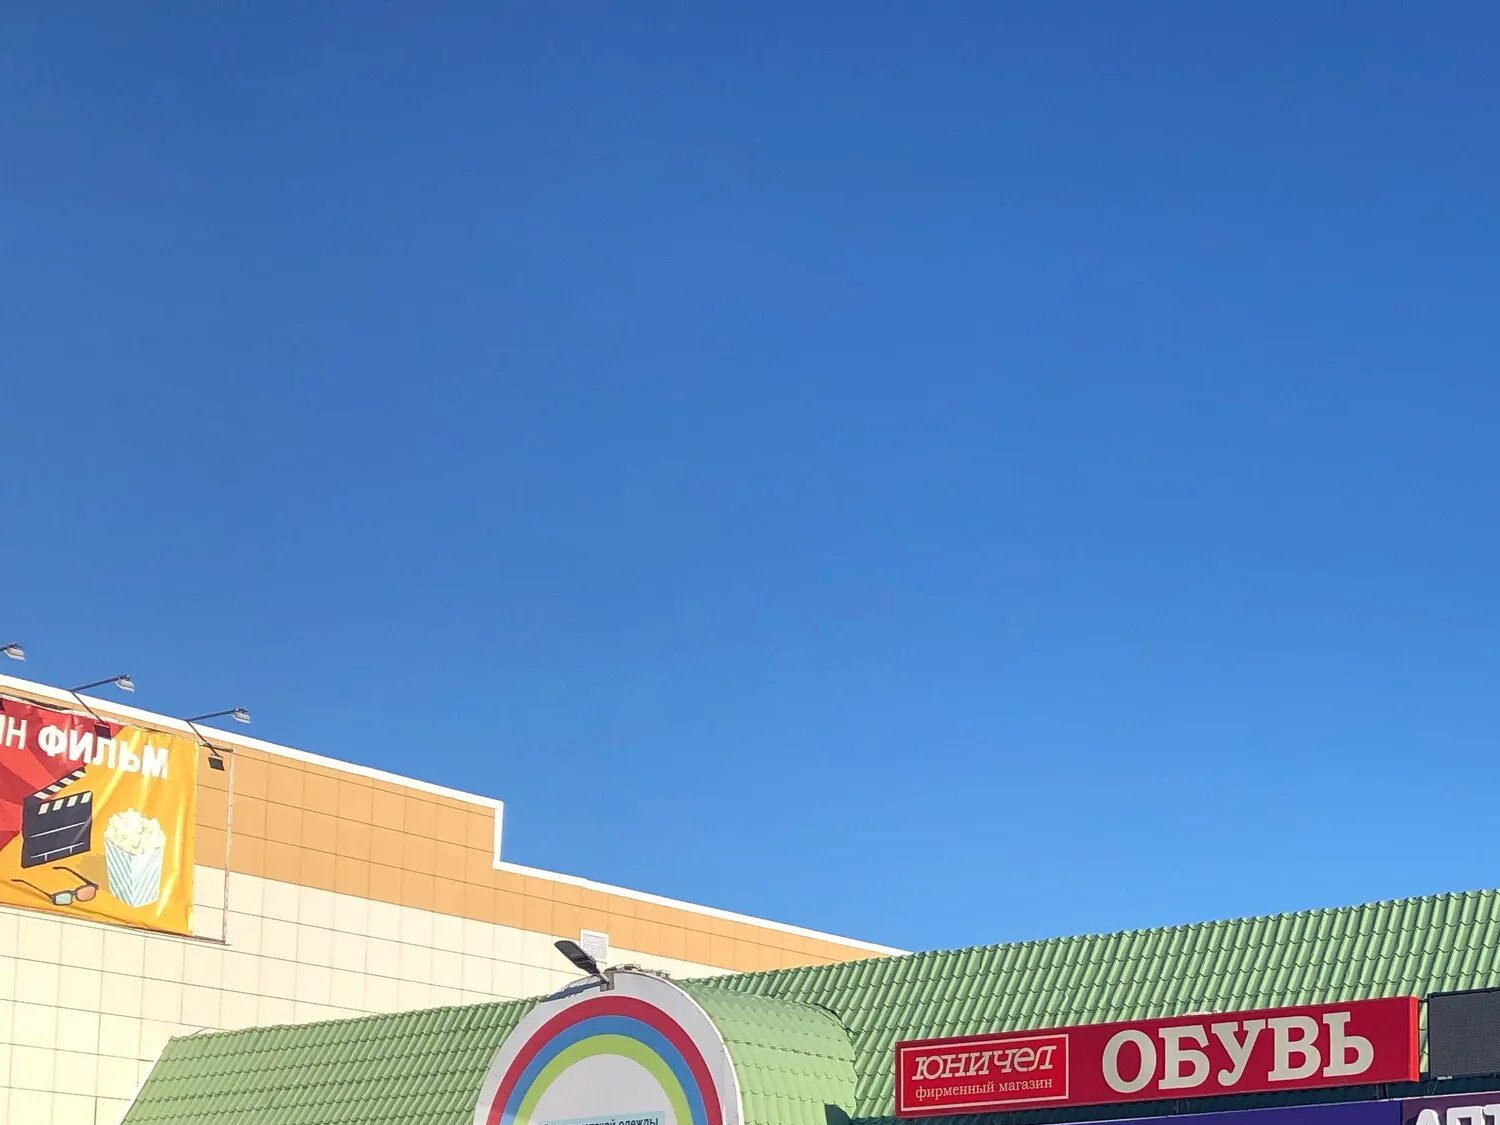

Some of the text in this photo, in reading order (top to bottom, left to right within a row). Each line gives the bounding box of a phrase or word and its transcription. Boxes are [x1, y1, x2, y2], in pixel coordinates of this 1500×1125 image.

[0, 714, 169, 780] Н ФИЛЬМ
[1102, 1011, 1375, 1094] ОБУВЬ
[915, 1078, 1053, 1102] фирменный магазин
